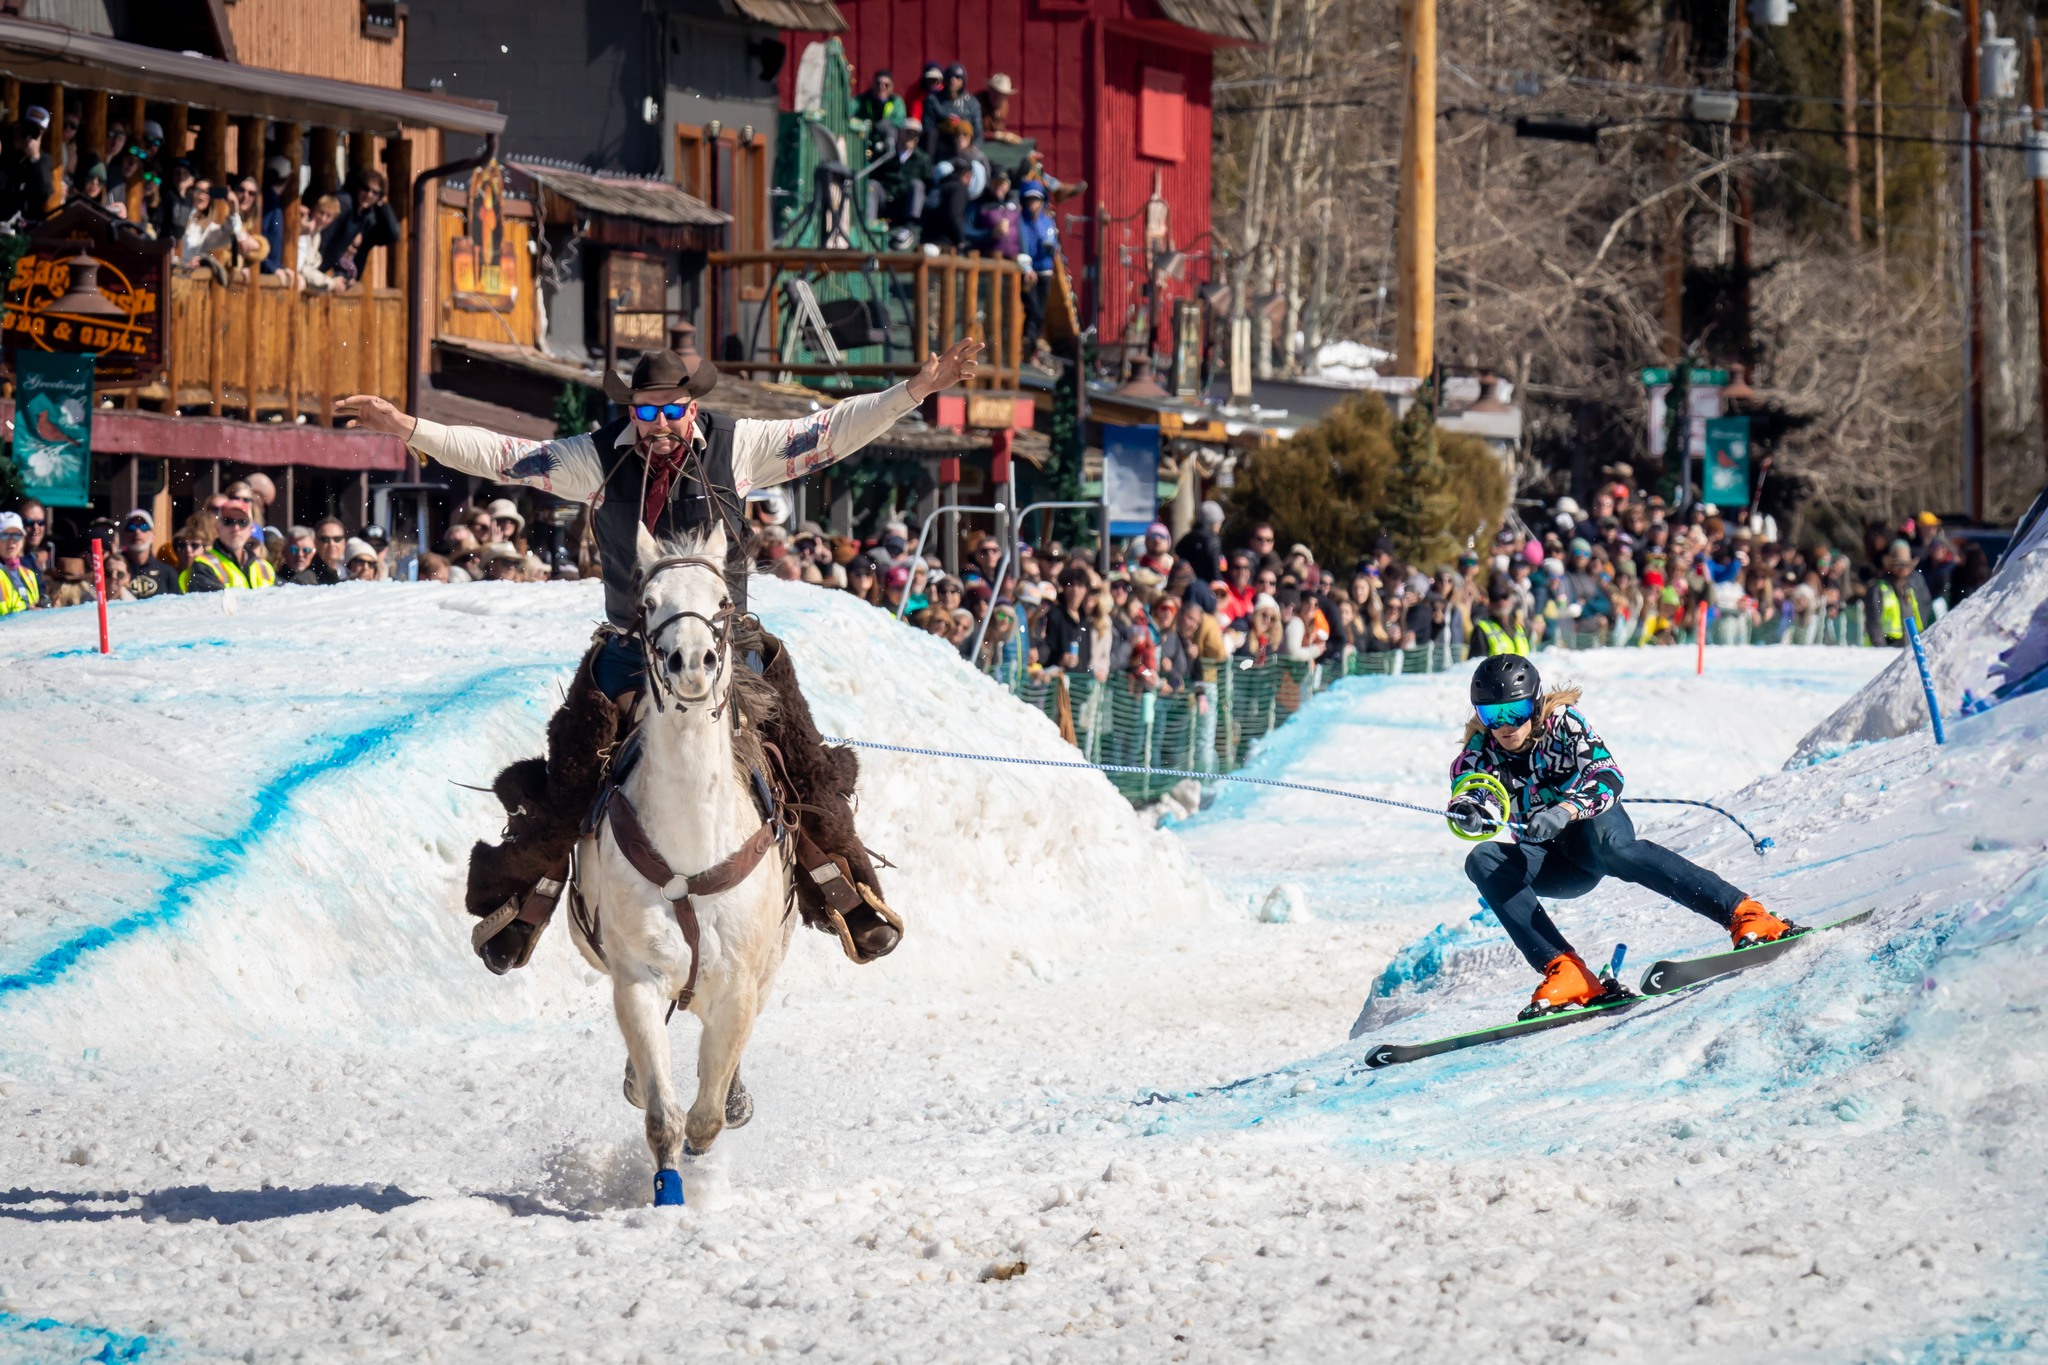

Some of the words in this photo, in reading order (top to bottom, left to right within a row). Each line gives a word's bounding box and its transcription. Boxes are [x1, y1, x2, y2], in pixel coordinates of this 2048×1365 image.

[3, 313, 46, 336] BBQ
[53, 322, 73, 341] &
[80, 326, 147, 354] GRILL
[22, 373, 86, 394] Greetings
